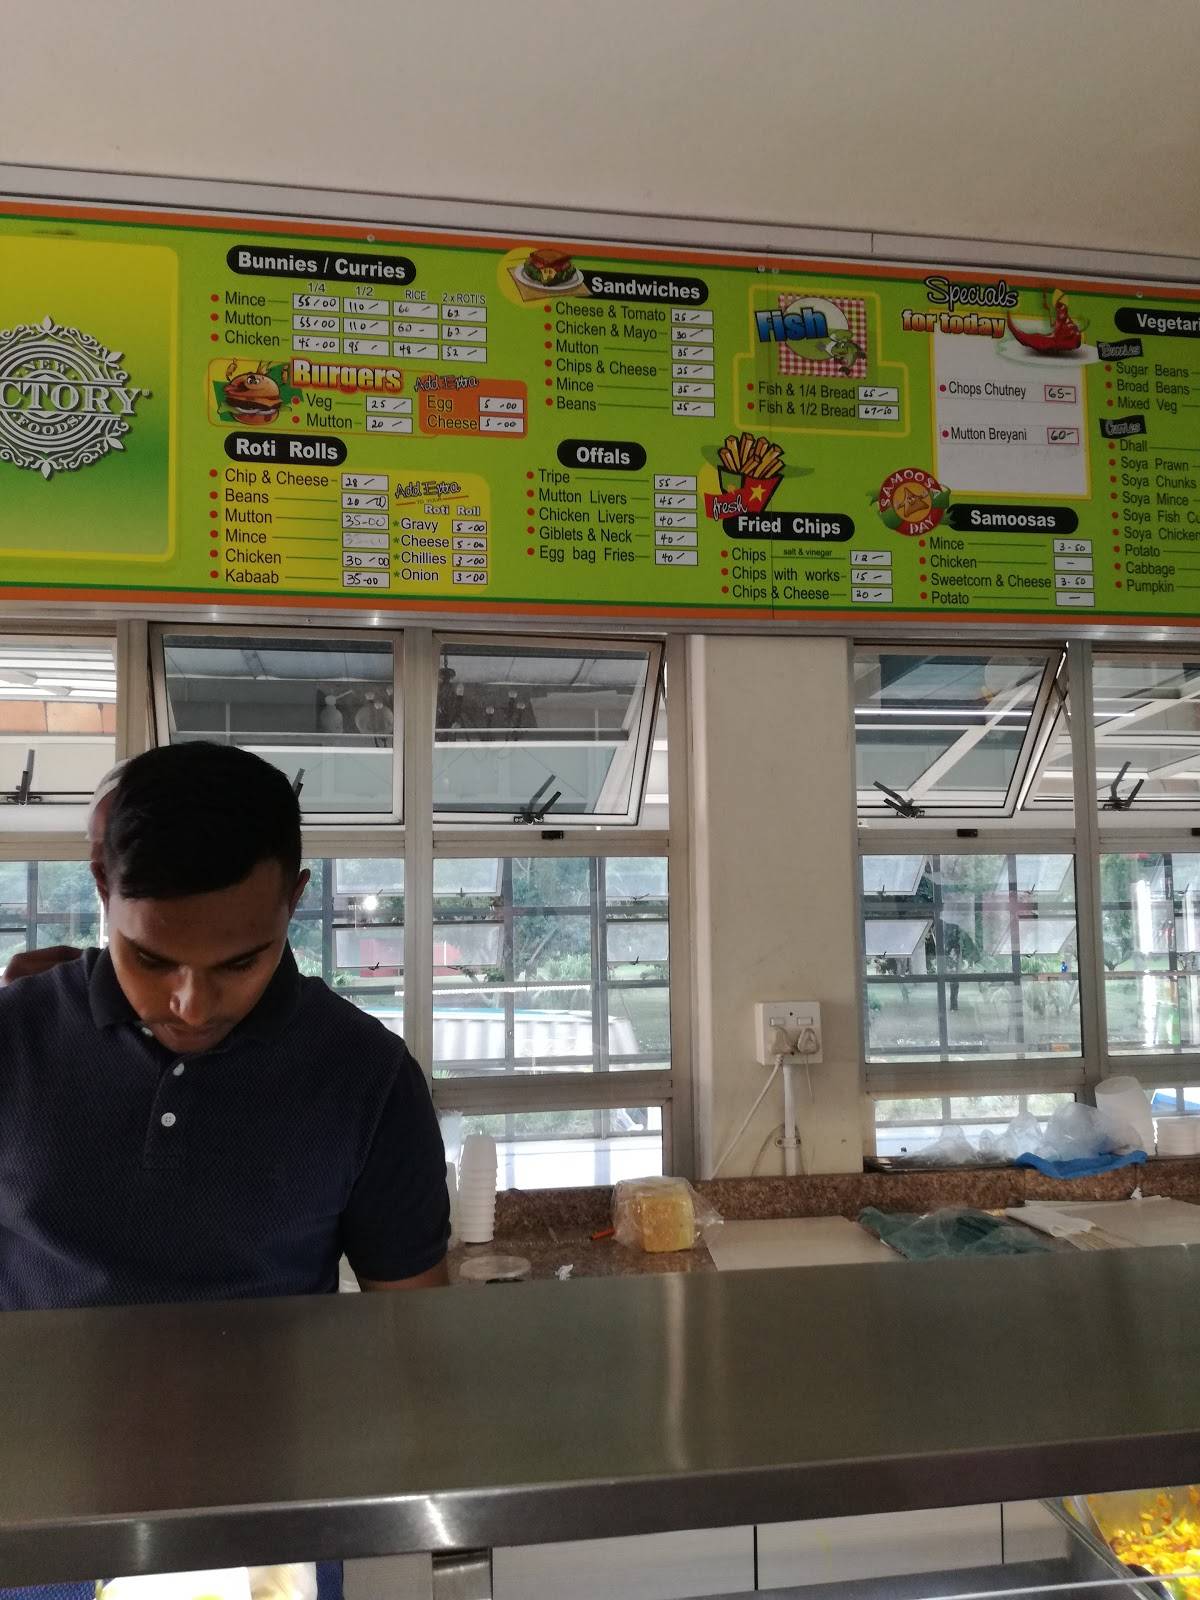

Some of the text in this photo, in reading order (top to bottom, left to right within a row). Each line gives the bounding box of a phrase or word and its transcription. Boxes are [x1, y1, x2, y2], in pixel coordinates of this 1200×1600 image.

[238, 251, 318, 273] Bunnies
[335, 258, 405, 279] Curries
[308, 282, 325, 293] 1/4
[356, 286, 373, 297] 1/2
[406, 290, 426, 301] RICE
[443, 293, 449, 303] 2
[457, 294, 486, 305] ROTI'S
[591, 277, 701, 299] Sandwiches
[924, 276, 1019, 312] Specials
[225, 291, 266, 307] Mince
[225, 311, 272, 327] Mutton
[556, 301, 666, 322] Cheese & Tomato
[556, 320, 657, 342] Chicken & Mayo
[755, 306, 829, 342] Fish
[902, 309, 1005, 338] for today
[225, 330, 280, 347] Chicken
[556, 340, 599, 355] Mutton
[22, 359, 70, 375] NEW
[556, 358, 657, 377] Chips & Cheese
[1116, 362, 1189, 378] Sugar Beans
[293, 360, 402, 392] Burgers
[556, 377, 594, 392] Mince
[758, 382, 855, 399] Fish & 1/4 Bread
[949, 381, 1026, 399] Chops Chutney
[1117, 379, 1190, 396] Broad Beans
[0, 381, 140, 415] CTORY
[306, 394, 332, 410] Veg
[428, 396, 453, 412] Egg
[557, 395, 597, 411] Beans
[1117, 397, 1178, 414] Mixed Veg
[759, 400, 856, 418] Fish & 1/2 Bread
[17, 415, 79, 436] FOODS
[306, 414, 353, 429] Mutton
[428, 415, 477, 430] Cheese
[951, 427, 1027, 443] Mutton Breyani
[236, 438, 338, 460] Roti Rolls
[1120, 440, 1148, 452] Dhall
[576, 446, 631, 465] Offals
[1121, 456, 1189, 472] Soya Prawn
[225, 468, 329, 487] Chip & Cheese
[538, 469, 570, 485] Tripe
[1122, 474, 1197, 489] Soya Chunks
[395, 483, 422, 499] Add
[538, 488, 627, 504] Mutton Livers
[880, 469, 942, 508] SAMOOSA
[225, 490, 269, 504] Beans
[1122, 491, 1189, 507] Soya Mince
[424, 504, 481, 517] Roti Roll
[539, 507, 635, 524] Chicken Livers
[712, 494, 747, 521] fresh
[225, 509, 273, 524] Mutton
[970, 510, 1056, 527] Samoosas
[1123, 509, 1151, 524] Soya
[1158, 511, 1180, 523] Fish
[401, 518, 439, 533] Gravy
[738, 515, 841, 537] Fried Chips
[909, 517, 936, 535] DAY
[225, 529, 267, 544] Mince
[401, 534, 450, 549] Cheese
[539, 526, 632, 543] Giblets & Neck
[1124, 526, 1152, 542] Soya
[930, 537, 964, 550] Mince
[1125, 544, 1160, 557] Potato
[225, 549, 281, 565] Chicken
[401, 551, 447, 565] Chillies
[540, 545, 635, 563] Egg bag Fries
[732, 548, 766, 563] Chips
[783, 548, 797, 556] salt
[805, 549, 833, 559] vinegar
[930, 555, 977, 568] Chicken
[225, 569, 279, 584] Kabaab
[401, 568, 439, 582] Onion
[732, 566, 840, 582] Chips with works
[1126, 561, 1175, 577] Cabbage
[931, 573, 1051, 588] Sweetcorn & Cheese
[1127, 579, 1174, 594] Pumpkin
[733, 585, 830, 600] Chips & Cheese
[931, 591, 969, 604] Potato
